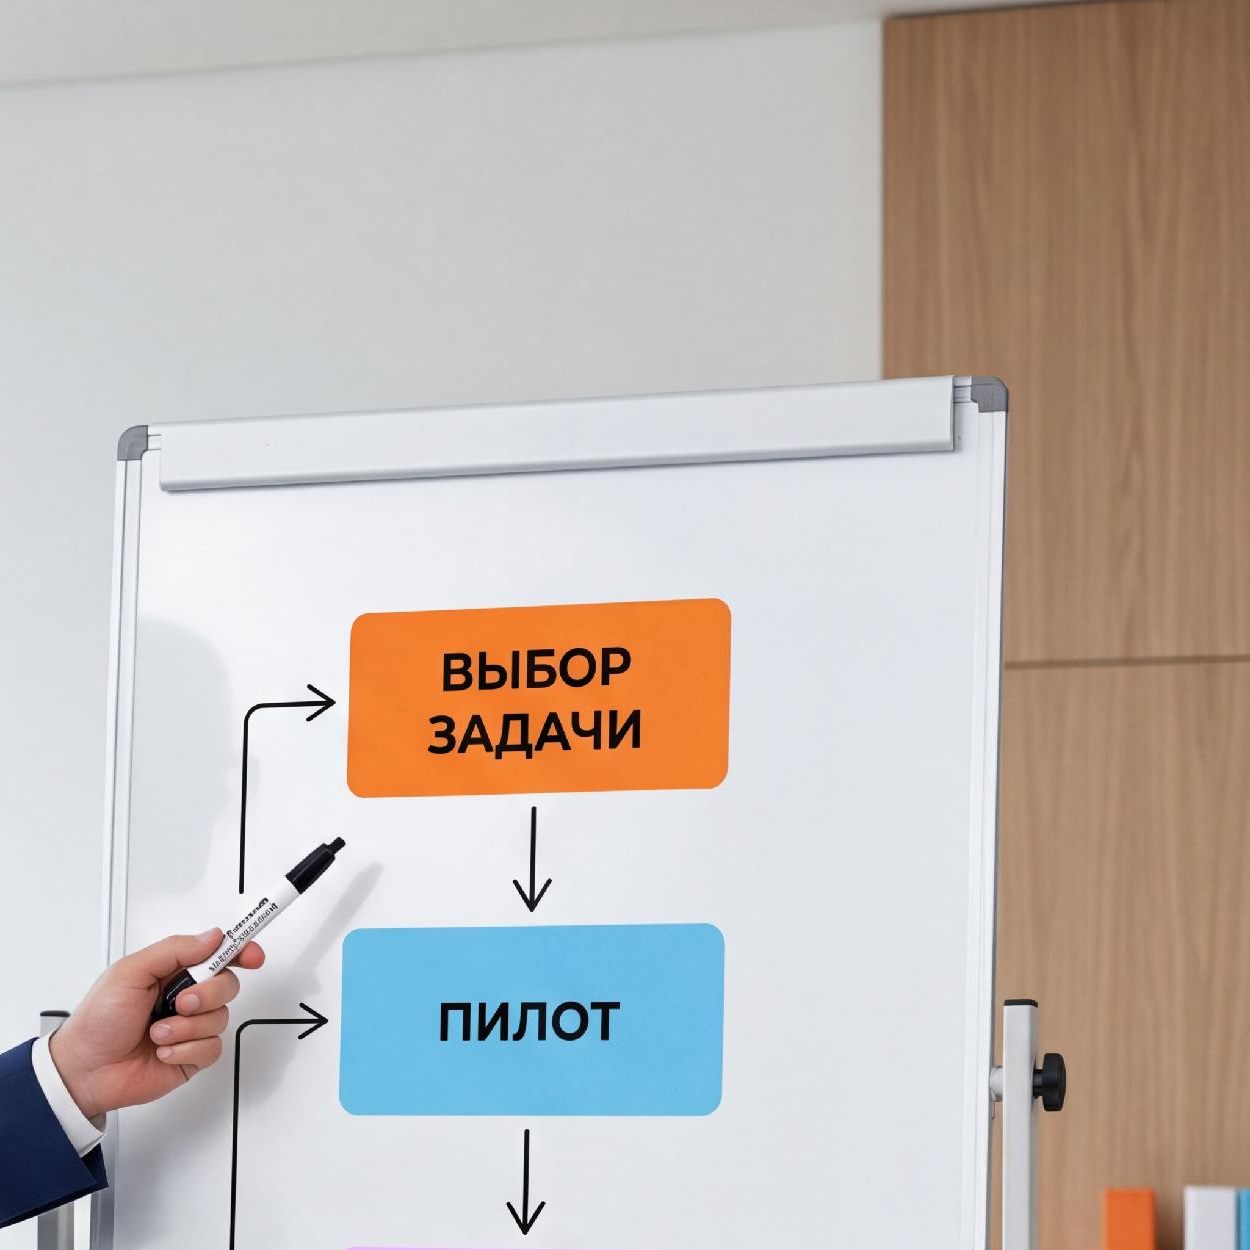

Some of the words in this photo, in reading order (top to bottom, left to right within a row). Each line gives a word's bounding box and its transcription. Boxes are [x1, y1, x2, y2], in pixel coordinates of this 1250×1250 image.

[442, 646, 632, 692] ВЫБОР
[427, 709, 643, 760] ЗАДАЧИ
[439, 1001, 621, 1042] ПИЛОТ
